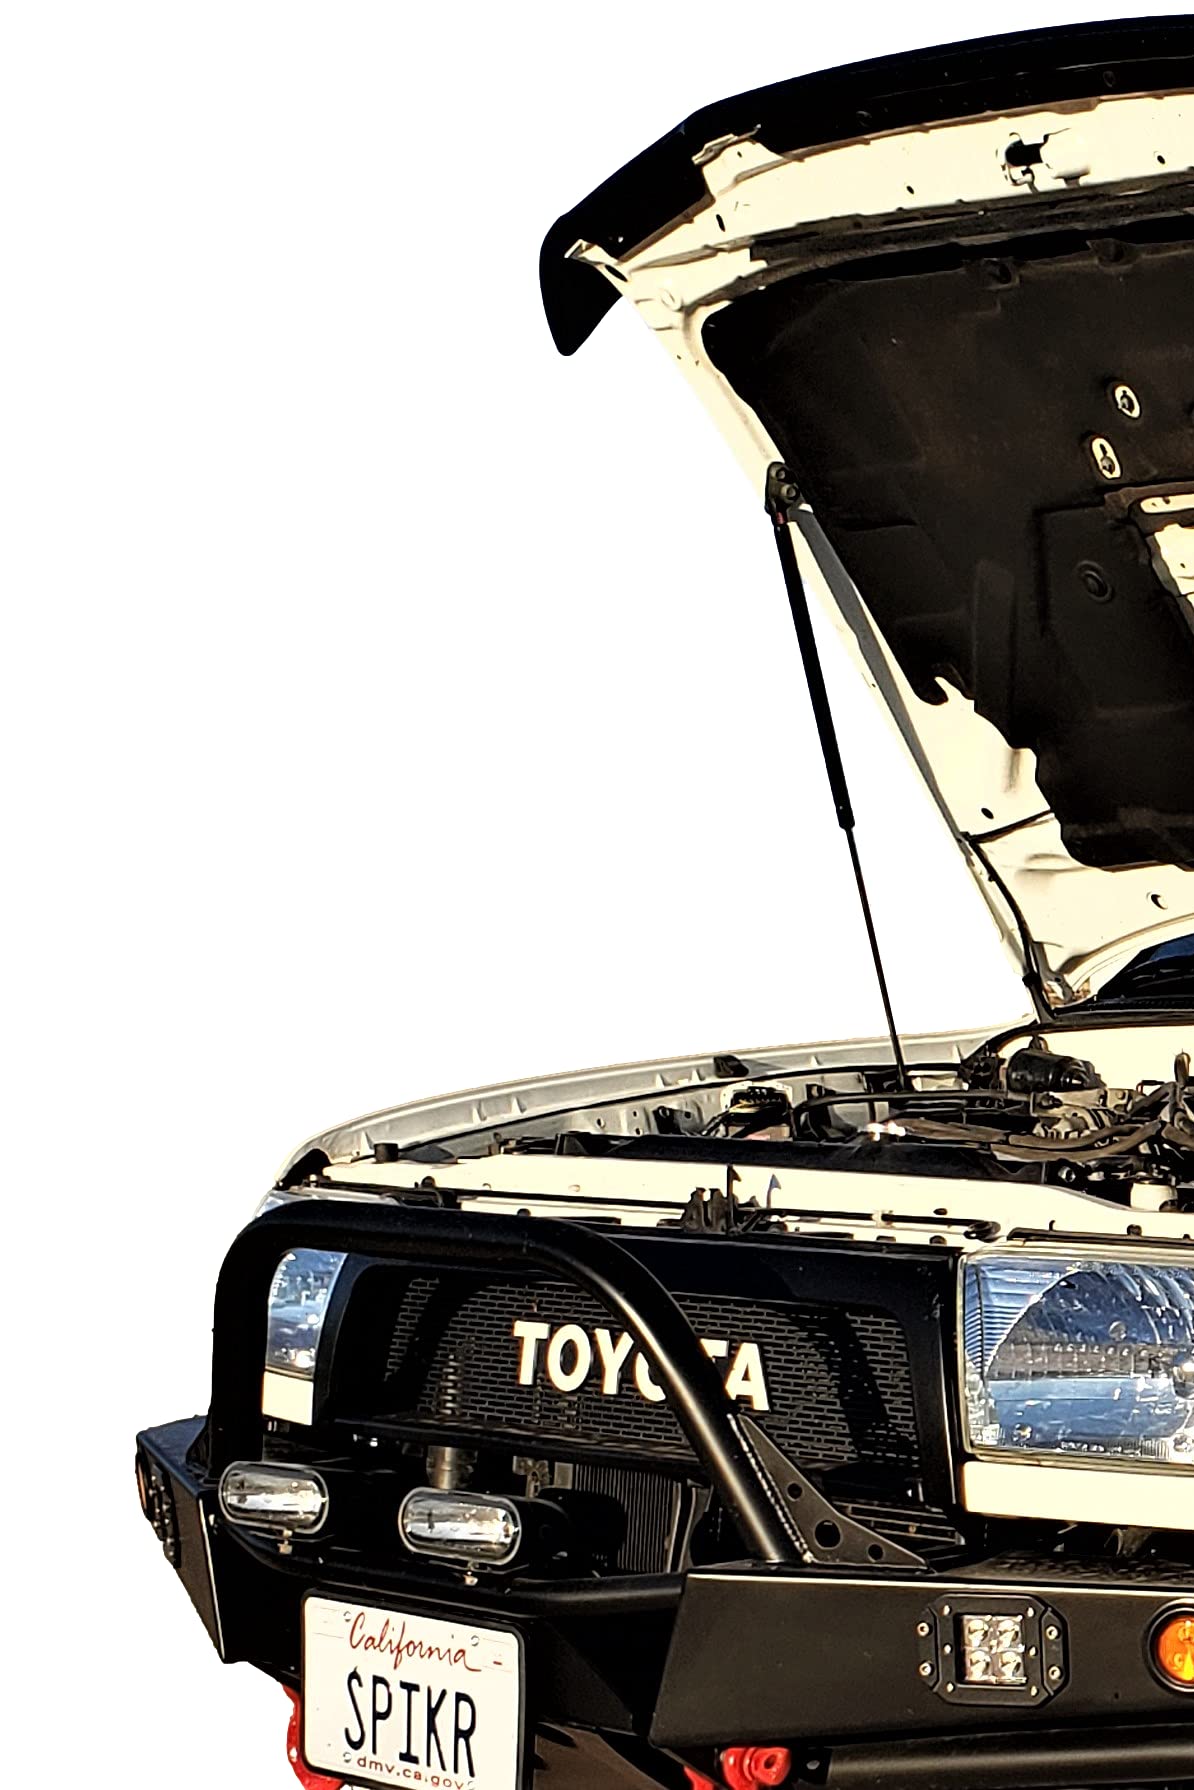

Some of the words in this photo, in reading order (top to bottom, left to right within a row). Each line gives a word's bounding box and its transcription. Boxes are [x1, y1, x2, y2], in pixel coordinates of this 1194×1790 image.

[349, 1611, 482, 1672] California
[344, 1667, 477, 1778] SPIKR
[356, 1755, 465, 1790] dmv.ca.gov
